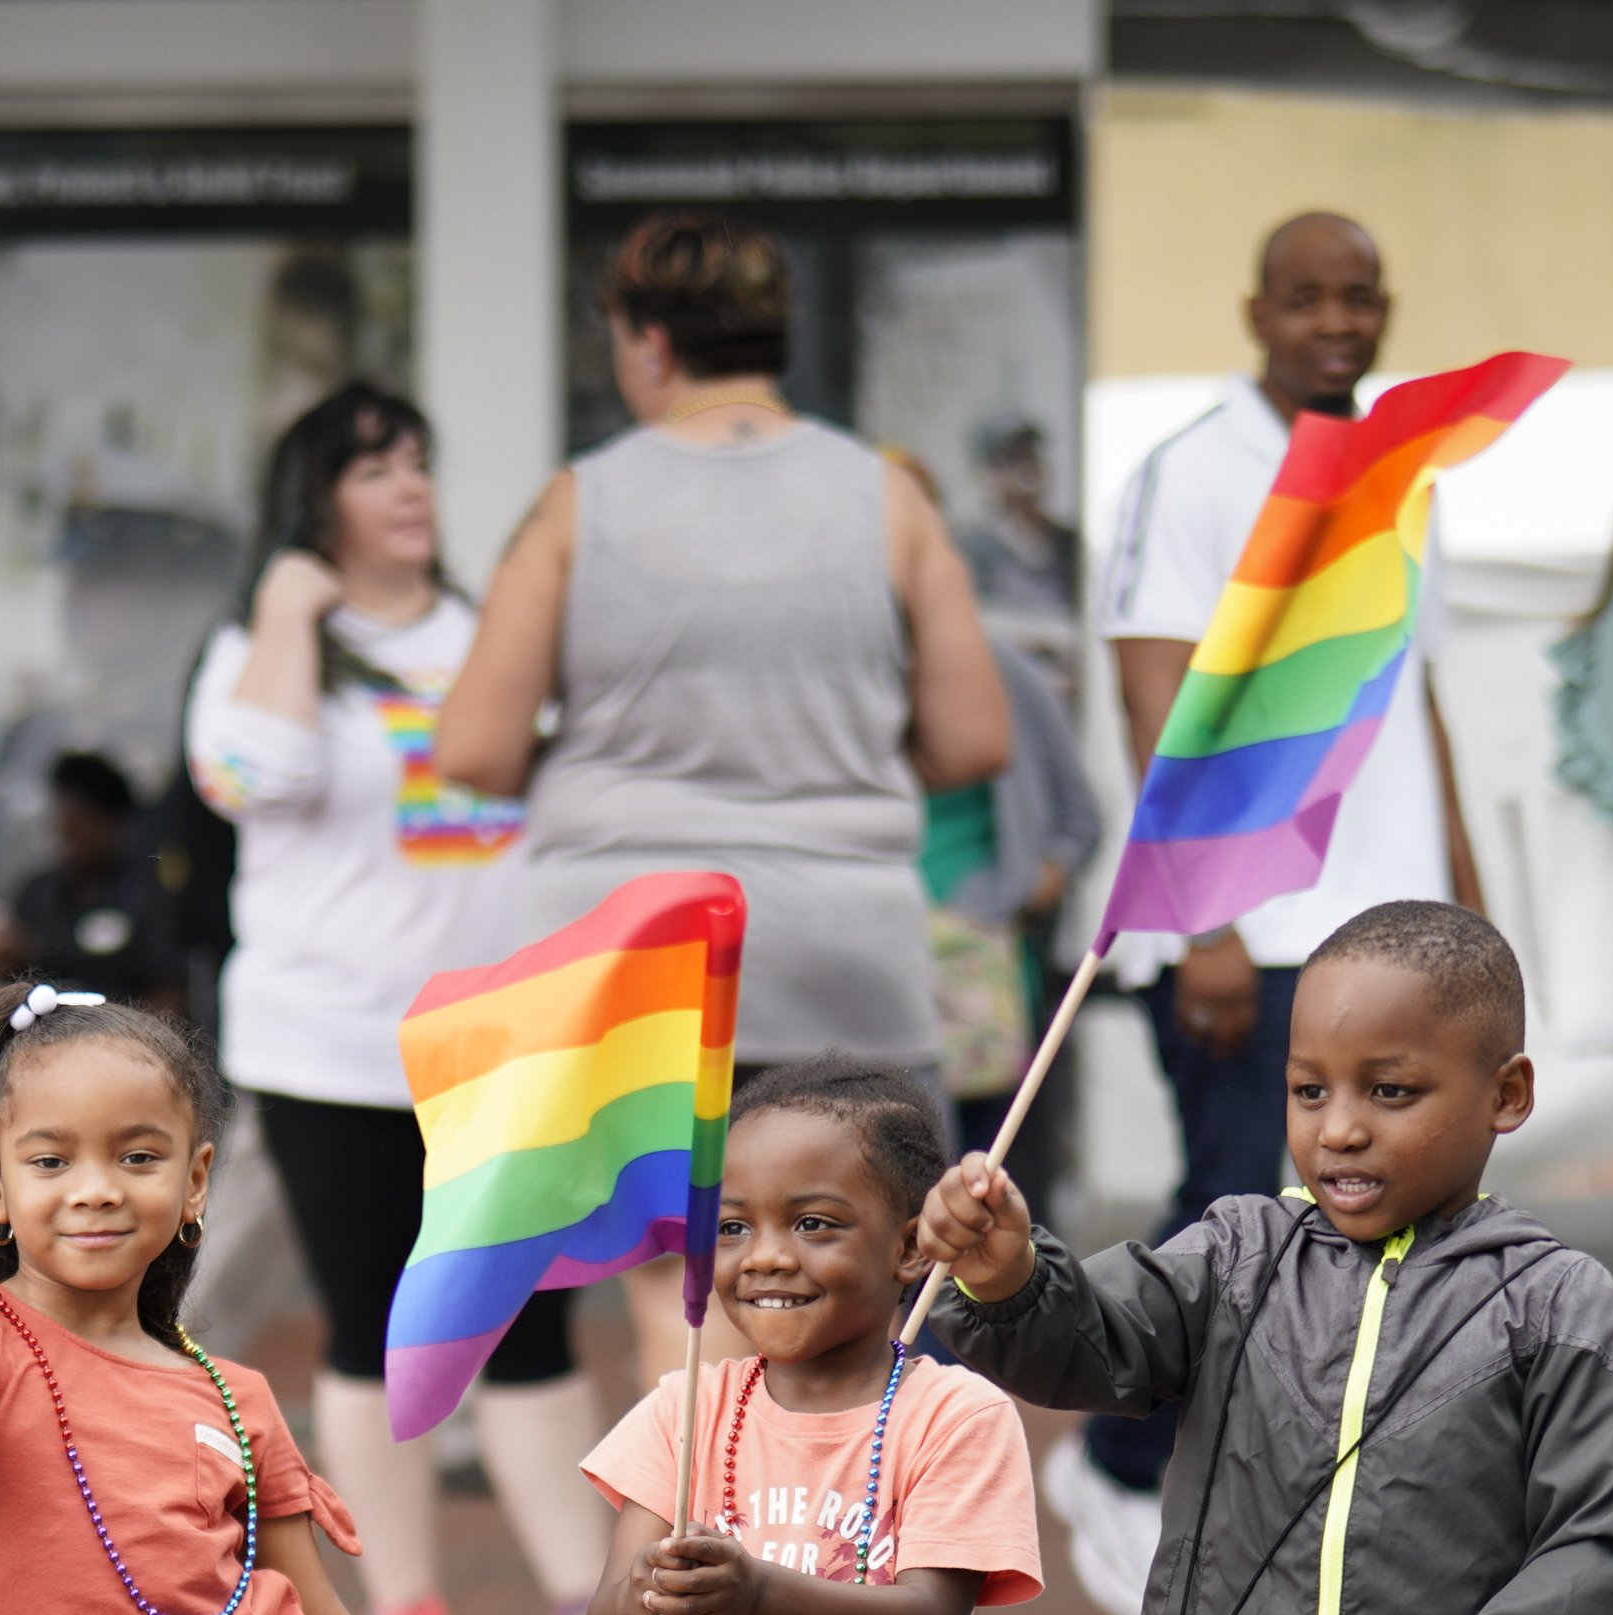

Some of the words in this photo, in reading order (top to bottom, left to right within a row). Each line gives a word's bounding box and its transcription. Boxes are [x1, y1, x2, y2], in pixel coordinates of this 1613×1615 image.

[749, 1487, 808, 1529] THE
[817, 1490, 894, 1570] ROAD
[762, 1542, 818, 1575] FOR
